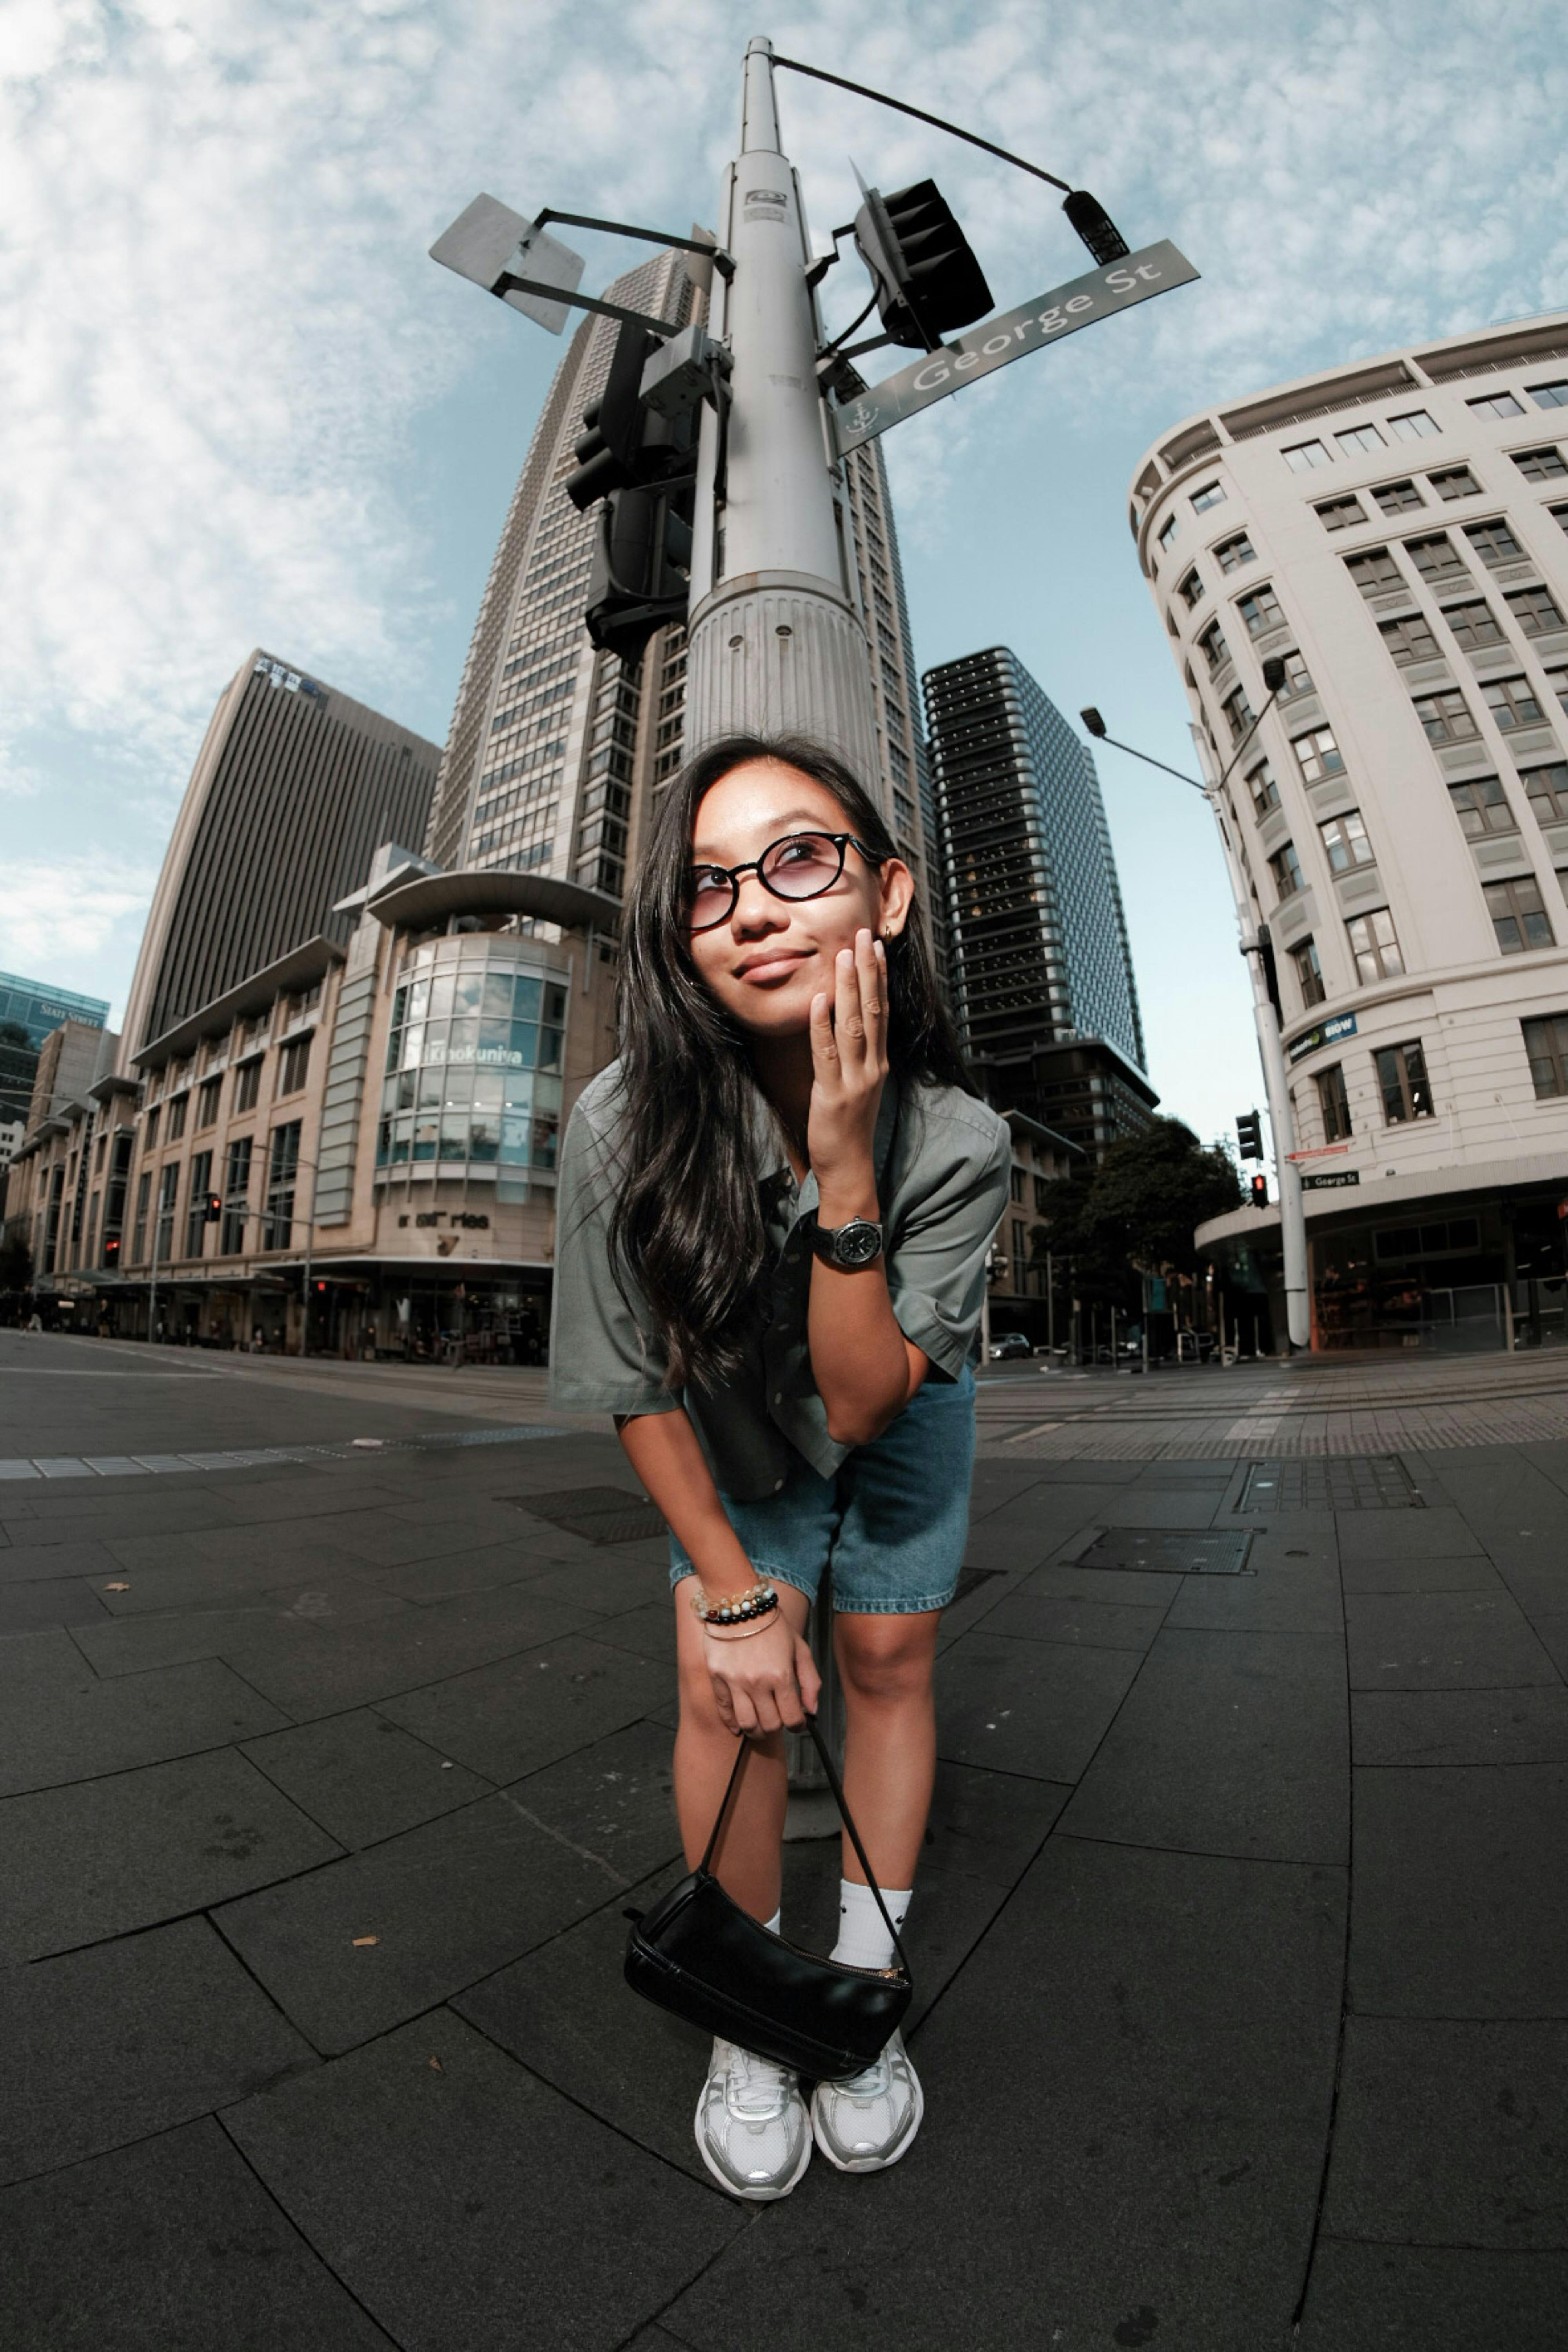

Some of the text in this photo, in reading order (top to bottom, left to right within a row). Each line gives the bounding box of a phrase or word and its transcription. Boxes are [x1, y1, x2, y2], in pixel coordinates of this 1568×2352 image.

[913, 262, 1163, 391] George St
[1315, 1174, 1356, 1186] George St
